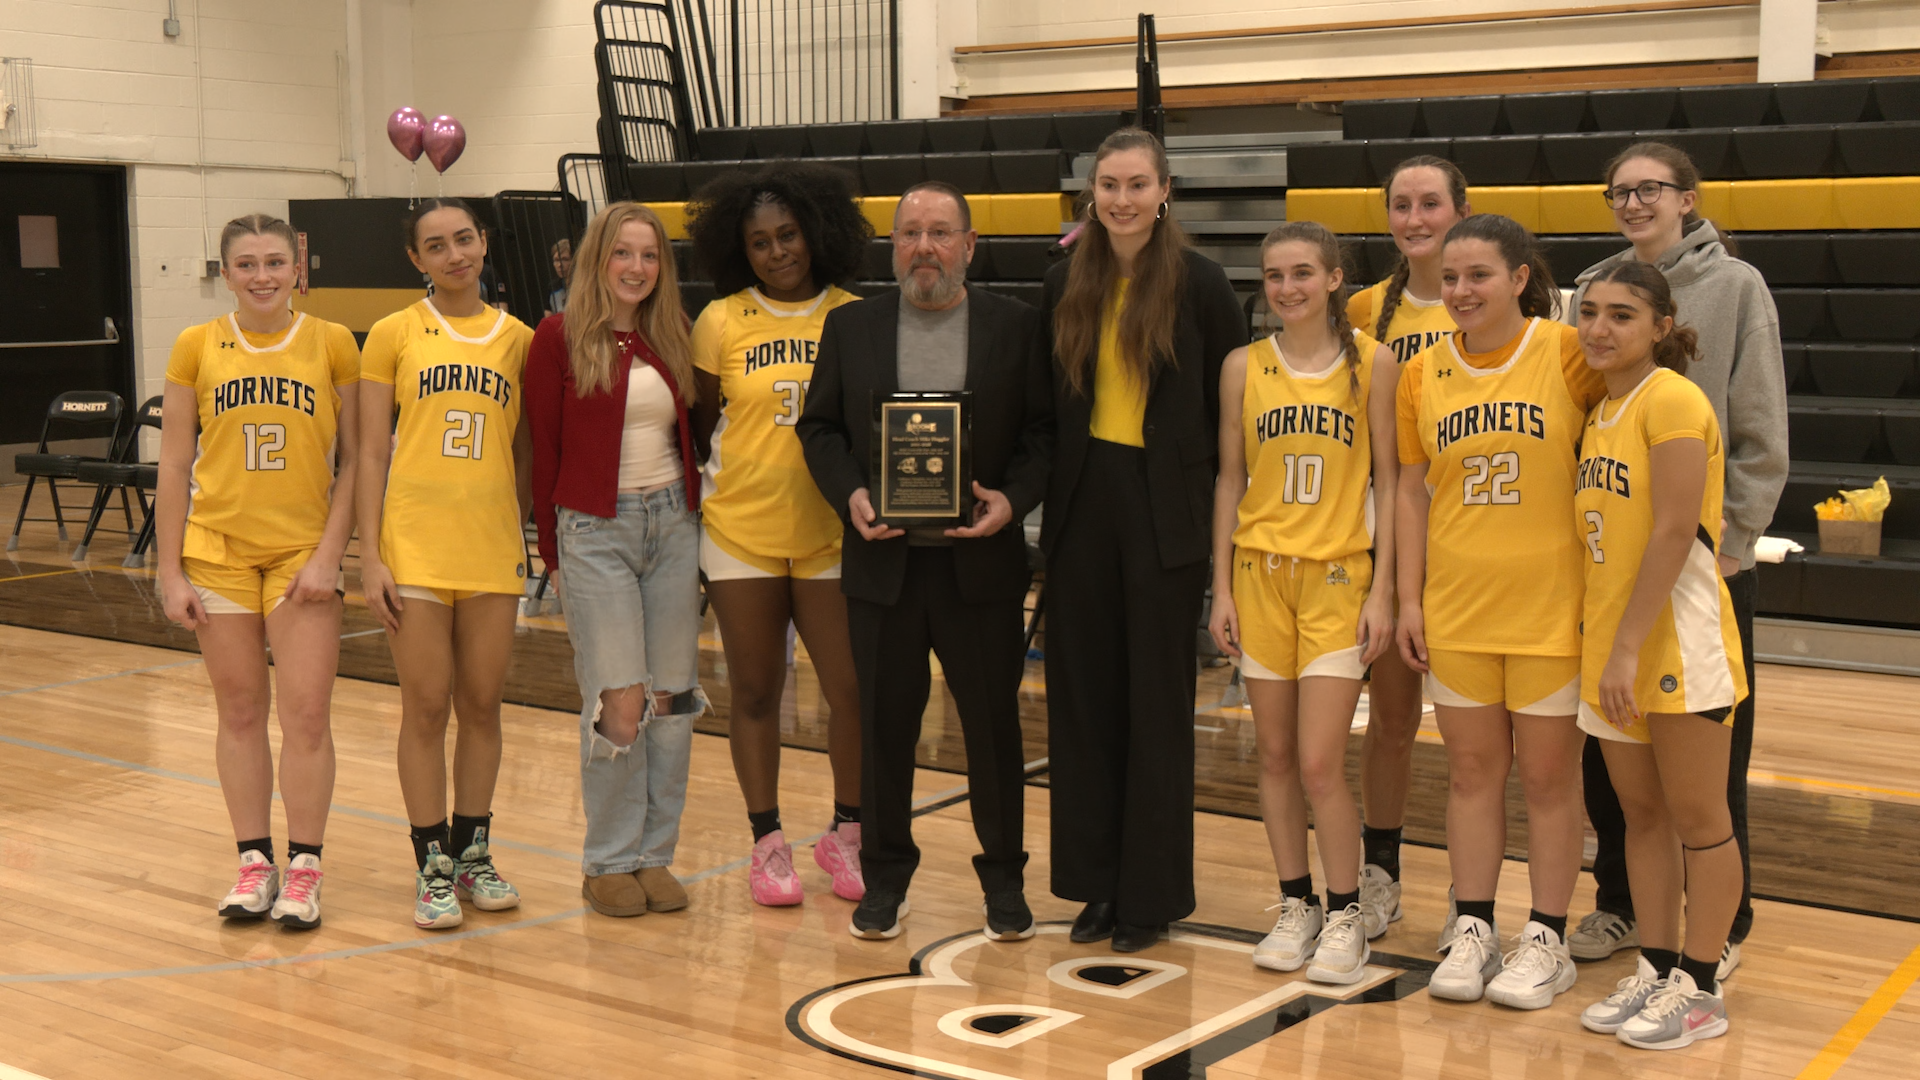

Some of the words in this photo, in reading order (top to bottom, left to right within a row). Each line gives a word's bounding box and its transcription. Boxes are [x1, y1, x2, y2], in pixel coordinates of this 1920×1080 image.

[744, 338, 821, 378] HORNE
[1386, 330, 1453, 364] ORN
[62, 402, 109, 412] HORNETS
[214, 375, 316, 418] HORNETS
[418, 363, 512, 410] HORNETS
[243, 423, 286, 471] 12
[442, 408, 486, 461] 21
[1256, 404, 1355, 449] HORNETS
[1437, 401, 1545, 455] HORNETS
[1282, 453, 1324, 505] 10
[1462, 451, 1520, 506] 22
[1574, 455, 1630, 499] RNETS
